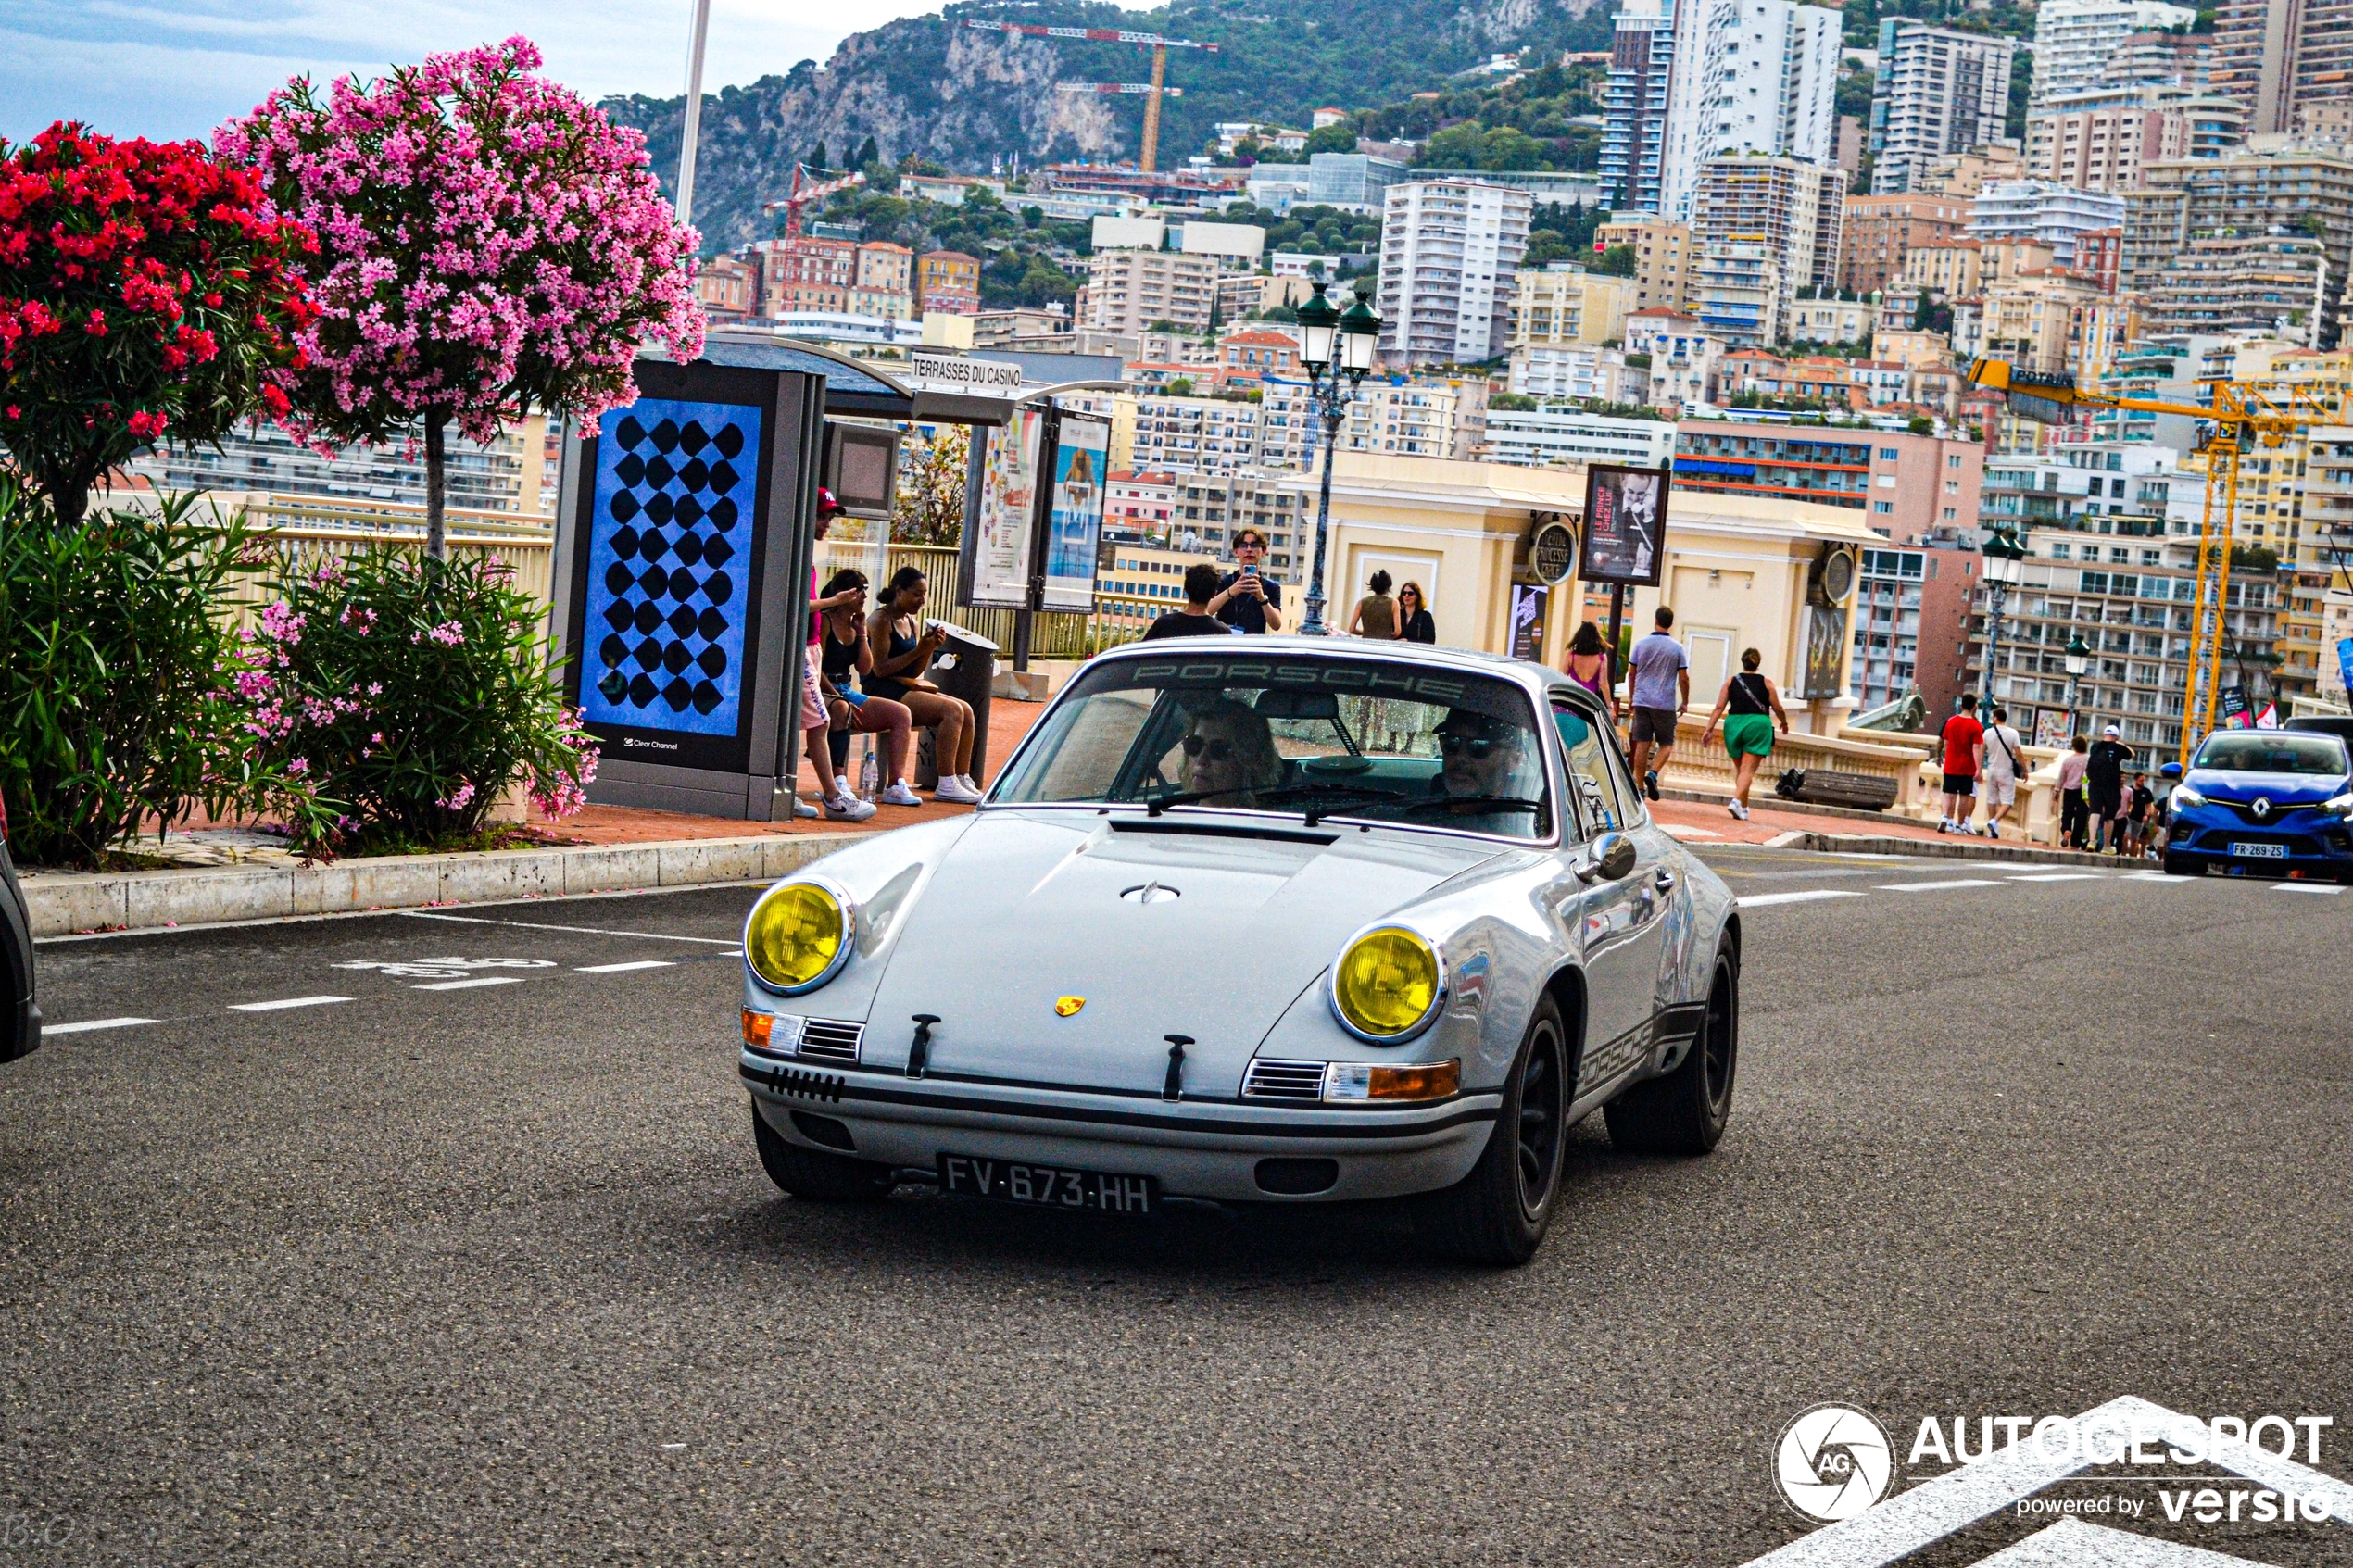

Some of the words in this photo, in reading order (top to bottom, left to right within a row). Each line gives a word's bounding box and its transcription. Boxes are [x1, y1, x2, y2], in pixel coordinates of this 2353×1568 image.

[913, 358, 970, 382] TERRASSES
[972, 365, 986, 383] DU
[987, 367, 1020, 387] CASINO
[1595, 486, 1605, 519] PRINCE
[1604, 492, 1613, 507] LUI
[1594, 519, 1604, 531] LE
[1603, 508, 1612, 532] CHEZ
[1132, 663, 1465, 699] PORSCHE
[633, 739, 650, 747] Clear
[650, 740, 679, 750] Channel
